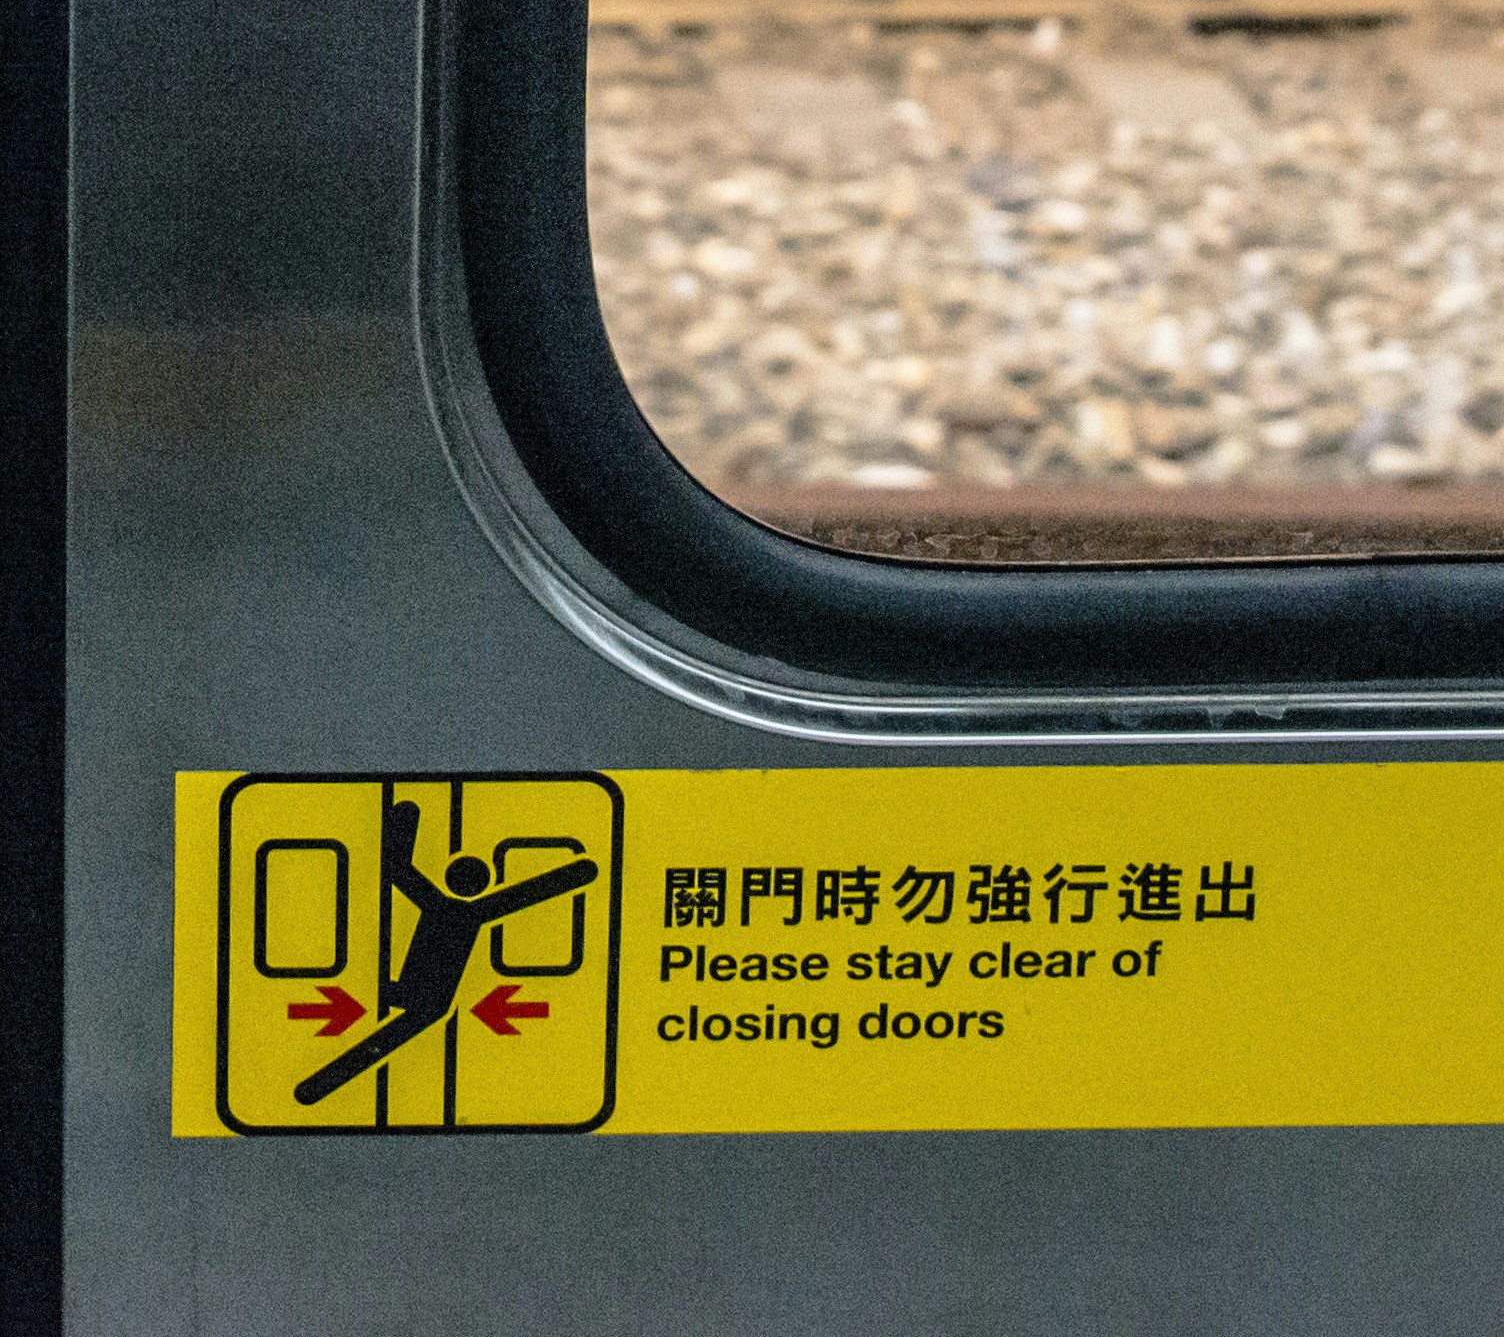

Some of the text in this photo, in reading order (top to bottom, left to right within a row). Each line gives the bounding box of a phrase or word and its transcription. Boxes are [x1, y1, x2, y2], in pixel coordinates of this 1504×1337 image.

[663, 861, 1257, 928] 關門時勿強行進出
[660, 939, 1164, 989] Please stay clear of
[656, 1002, 1004, 1050] closing doors
